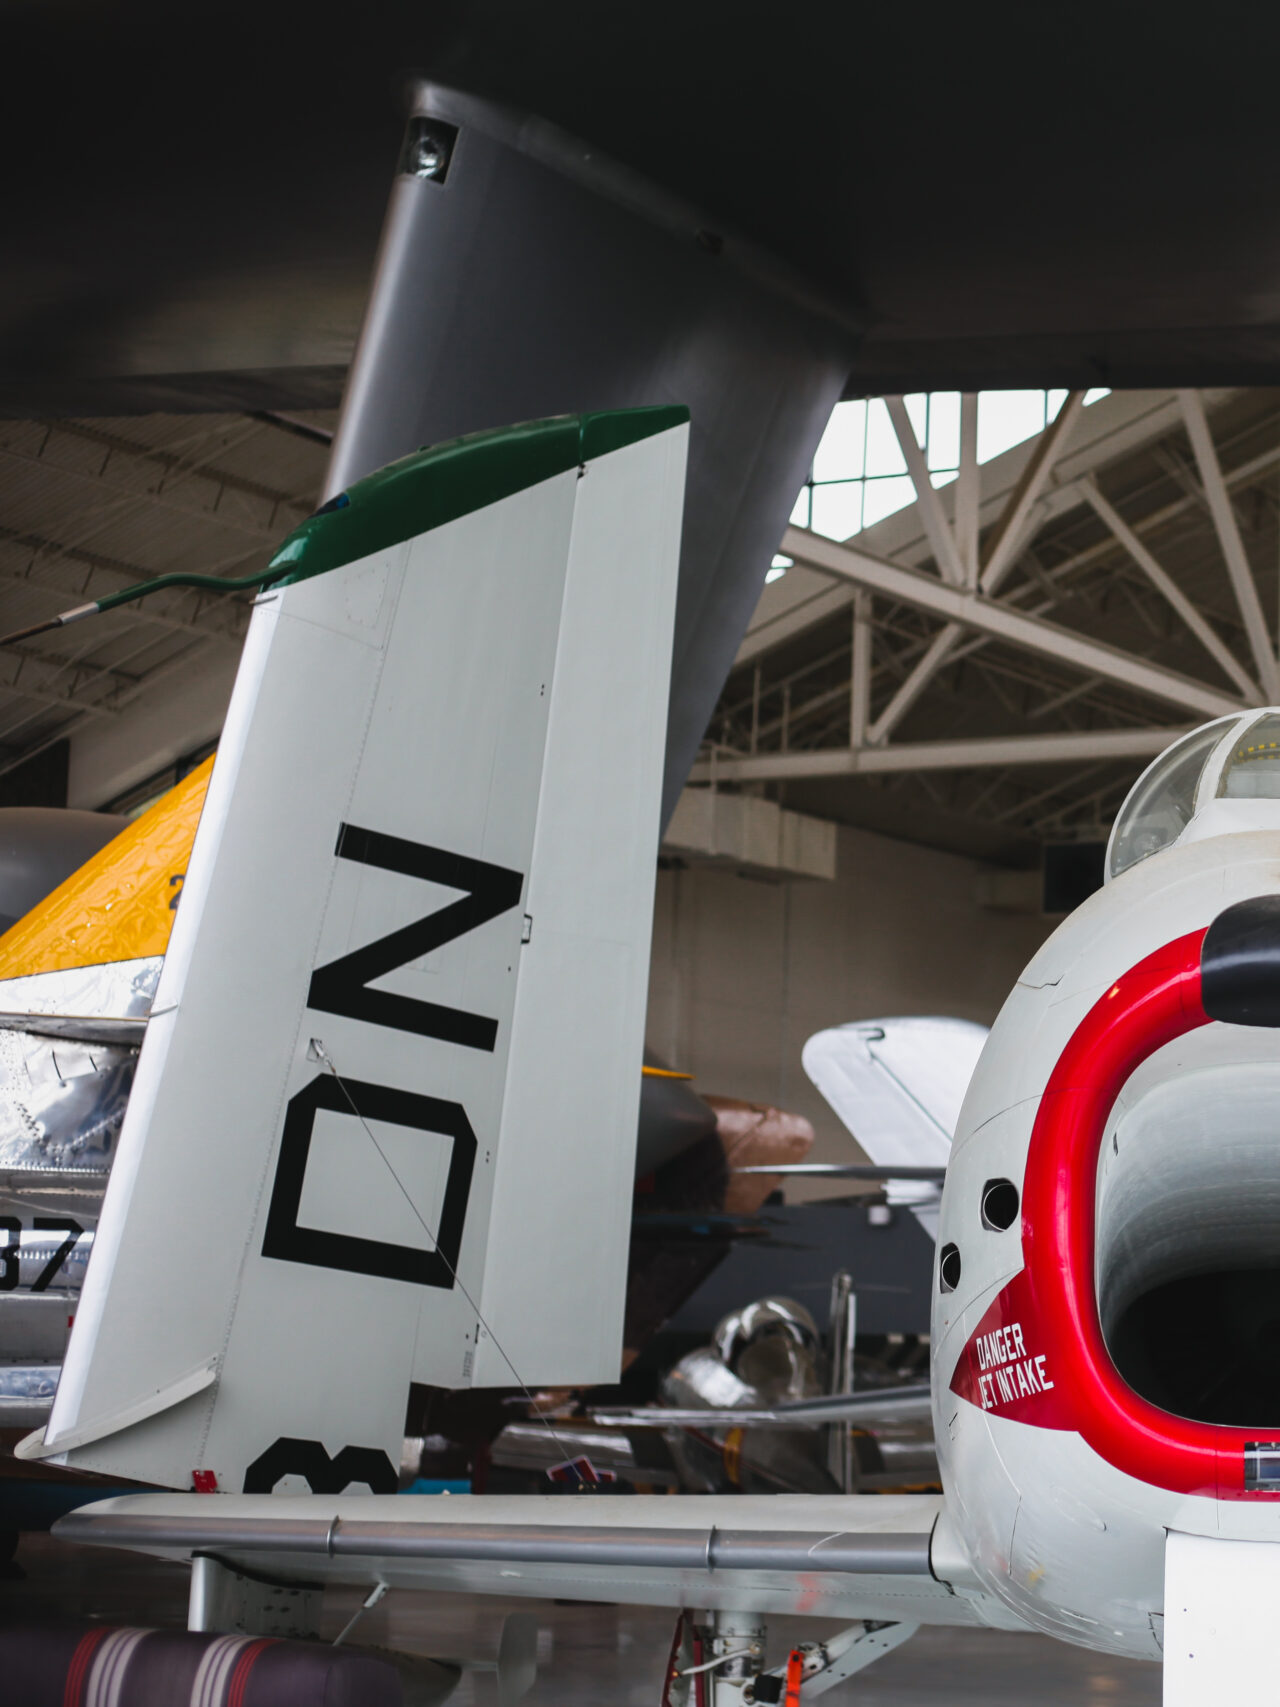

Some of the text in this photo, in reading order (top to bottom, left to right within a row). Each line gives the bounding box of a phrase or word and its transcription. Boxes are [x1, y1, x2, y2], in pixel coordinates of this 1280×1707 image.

[975, 1322, 1027, 1371] DANGER
[977, 1354, 1055, 1410] JET INTAKE
